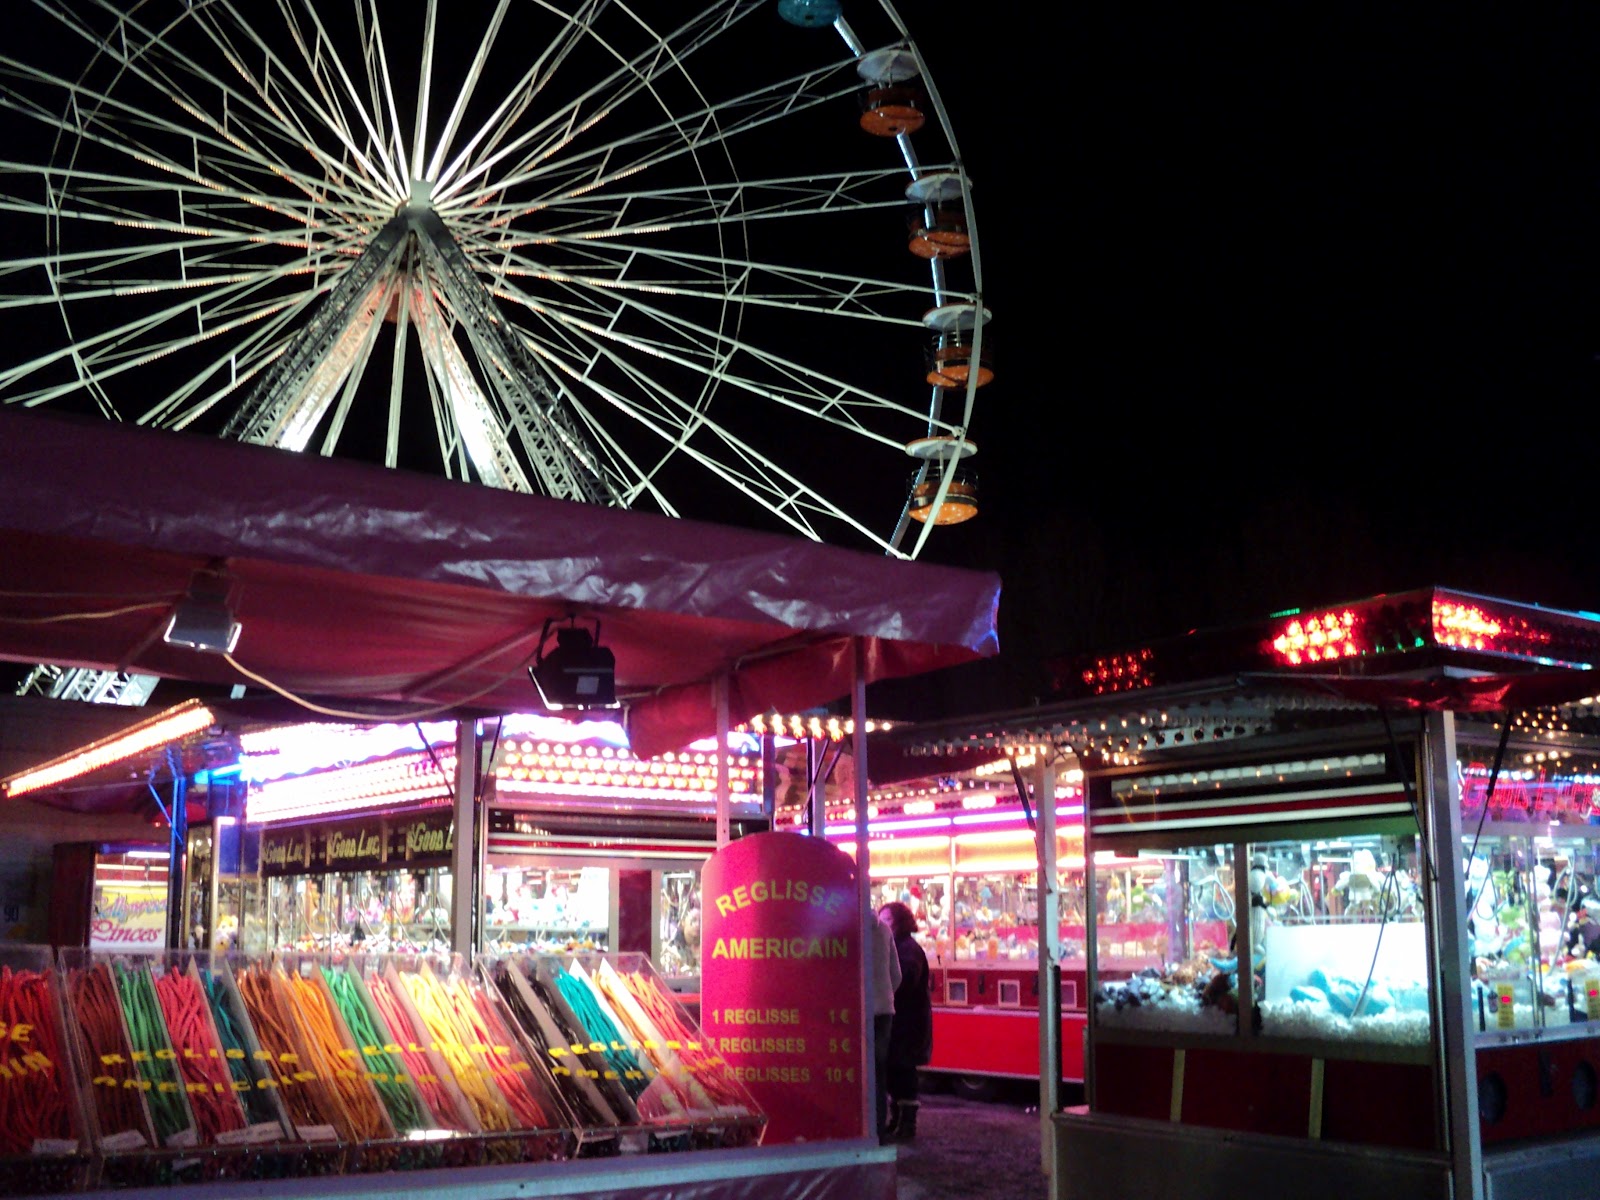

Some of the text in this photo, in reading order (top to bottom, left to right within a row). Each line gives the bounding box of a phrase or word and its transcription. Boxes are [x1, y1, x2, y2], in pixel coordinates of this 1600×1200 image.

[715, 879, 844, 917] REGLISSE
[711, 938, 848, 959] AMERICAIN
[712, 1009, 719, 1024] 1
[724, 1009, 800, 1024] REGLISSE
[829, 1009, 835, 1023] 1
[720, 1038, 806, 1053] REGLISSES
[829, 1039, 837, 1053] 5
[723, 1068, 810, 1083] REGLISSES
[826, 1068, 842, 1083] 10
